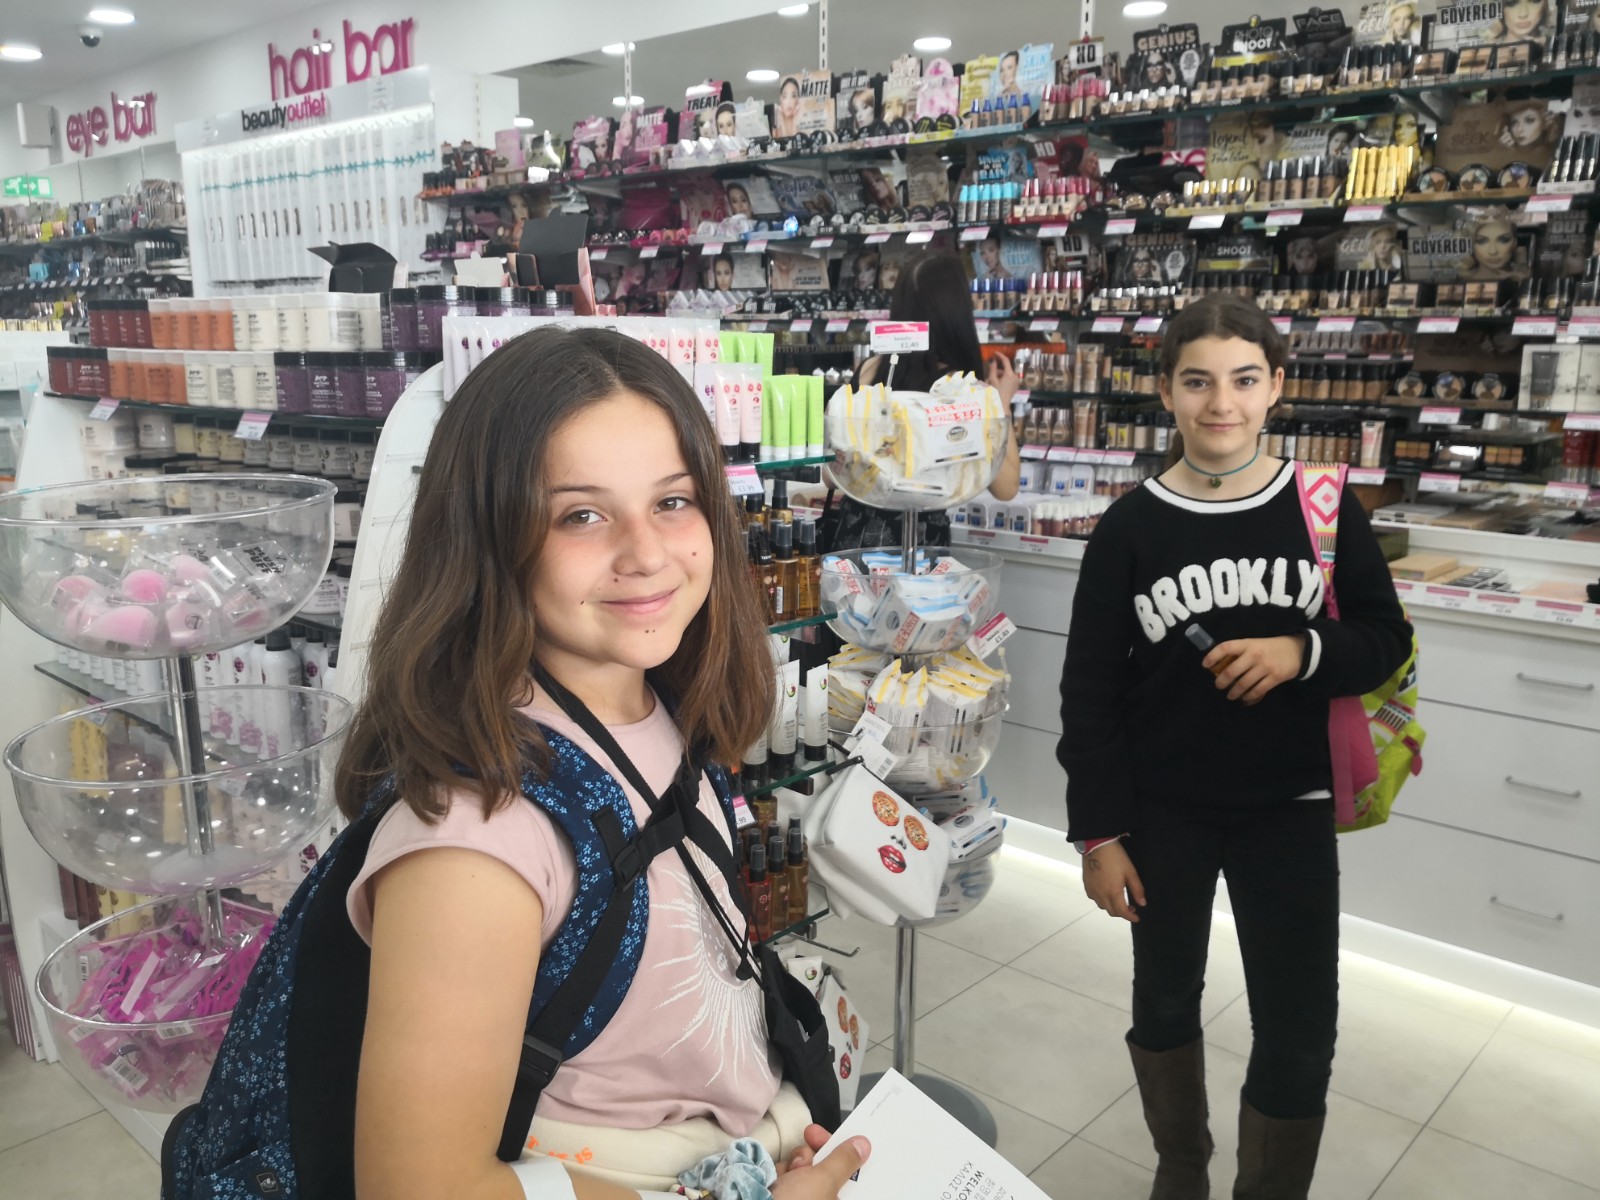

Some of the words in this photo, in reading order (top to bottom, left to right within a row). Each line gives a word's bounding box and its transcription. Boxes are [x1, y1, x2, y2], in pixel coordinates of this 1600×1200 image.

[1440, 3, 1503, 25] COVERED!
[1137, 29, 1197, 51] GENIUS
[268, 29, 333, 101] hair
[343, 17, 414, 83] bar
[801, 80, 829, 96] MATTE
[687, 95, 718, 111] TREAT
[66, 104, 109, 156] eye
[111, 90, 158, 141] bar
[1062, 235, 1083, 251] HD
[1411, 237, 1473, 256] COVERED!
[955, 1169, 985, 1200] WELKO
